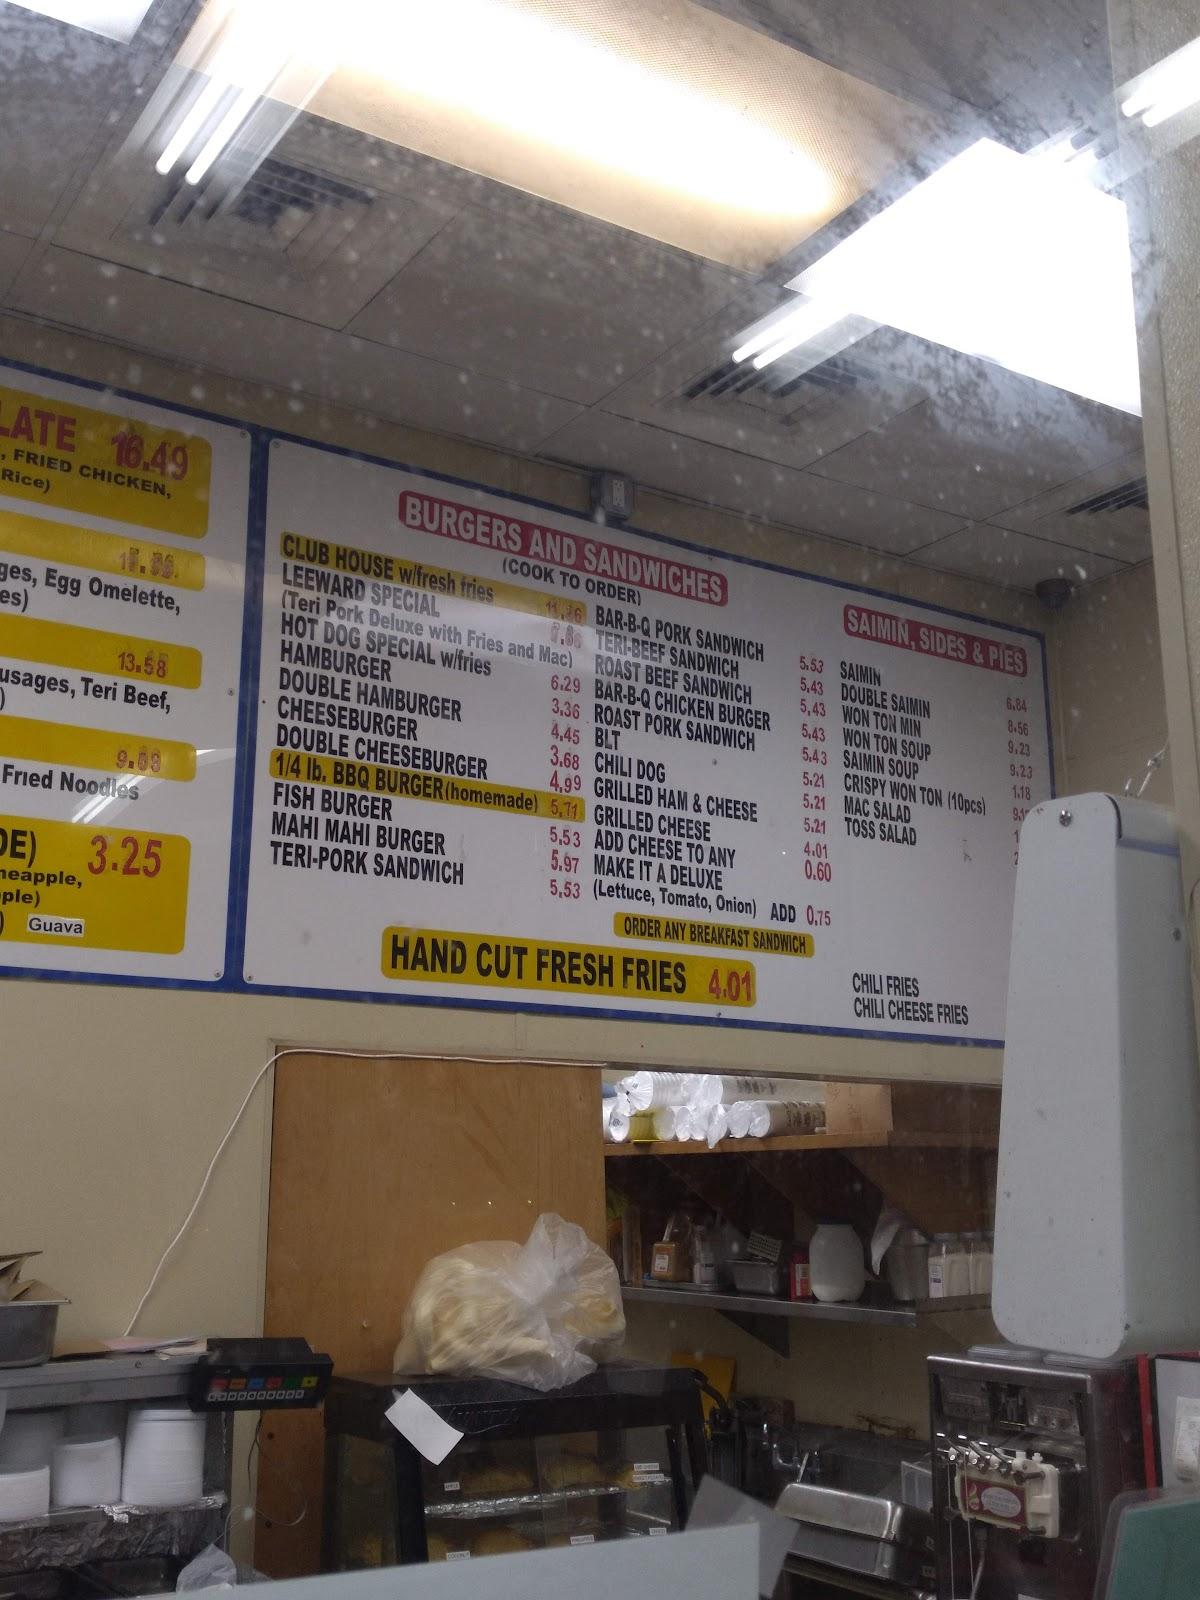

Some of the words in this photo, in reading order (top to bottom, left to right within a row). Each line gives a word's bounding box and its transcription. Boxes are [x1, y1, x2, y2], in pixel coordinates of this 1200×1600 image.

[1, 468, 51, 494] Rice)
[14, 449, 72, 473] FRIED
[79, 458, 172, 499] CHICKEN,
[283, 534, 330, 565] CLUB
[335, 547, 394, 580] HOUSE
[399, 564, 456, 595] w/fresh
[461, 579, 494, 603] fries
[405, 496, 521, 552] BURGERS
[529, 529, 577, 566] AND
[584, 543, 722, 603] SANDWICHES
[45, 567, 81, 597] Egg
[89, 577, 180, 615] Omelette,
[283, 562, 365, 601] LEEWARD
[371, 582, 440, 618] SPECIAL
[503, 557, 555, 584] (COOK
[560, 571, 579, 590] TO
[585, 579, 642, 606] ORDER)
[282, 590, 320, 614] (Teri
[327, 600, 363, 624] Pork
[370, 609, 423, 636] Deluxe
[429, 623, 461, 645] with
[468, 629, 503, 653] Fries
[508, 643, 534, 659] and
[539, 645, 572, 668] Mac)
[282, 613, 317, 640] HOT
[324, 621, 360, 649] DOG
[367, 630, 435, 665] SPECIAL
[441, 649, 491, 676] w/fries
[551, 675, 580, 693] 6.29
[596, 605, 650, 637] BAR-B-Q
[656, 620, 691, 644] PORK
[696, 629, 763, 661] SANDWICH
[800, 656, 824, 674] 5.53
[596, 630, 665, 663] TERI-BEEF
[670, 647, 738, 679] SANDWICH
[847, 609, 916, 650] SAIMIN,
[919, 628, 967, 661] SIDES
[973, 642, 984, 666] &
[989, 646, 1024, 674] PIES
[81, 677, 117, 700] Teri
[124, 688, 171, 713] Beef,
[281, 640, 391, 682] HAMBURGER
[552, 698, 580, 719] 3.36
[595, 654, 641, 682] ROAST
[645, 665, 678, 689] BEEF
[683, 673, 752, 704] SANDWICH
[840, 660, 881, 687] SAIMIN
[1007, 697, 1028, 714] 6.84
[280, 667, 350, 701] DOUBLE
[357, 681, 462, 722] HAMBURGER
[551, 723, 580, 745] 4.45
[595, 679, 650, 708] BAR-B-Q
[655, 691, 714, 720] CHICKEN
[719, 703, 771, 731] BURGER
[802, 724, 826, 742] 5.43
[841, 683, 888, 711] DOUBLE
[891, 694, 930, 719] SAIMIN
[1008, 720, 1029, 736] 8.56
[842, 705, 870, 728] WON
[873, 711, 897, 733] TON
[900, 717, 921, 738] MIN
[1008, 741, 1030, 757] 9.23
[277, 724, 349, 757] DOUBLE
[355, 737, 487, 780] CHEESEBURGER
[278, 696, 417, 741] CHEESEBURGER
[550, 745, 580, 770] 3.68
[595, 704, 640, 731] ROAST
[645, 713, 682, 738] PORK
[686, 721, 755, 751] SANDWICH
[802, 747, 827, 765] 5.43
[595, 727, 620, 750] BLT
[803, 772, 825, 788] 5.21
[843, 728, 870, 751] WON
[874, 734, 898, 756] TON
[901, 739, 931, 762] SOUP
[1010, 763, 1033, 780] 9.23
[3, 764, 53, 789] Fried
[61, 772, 139, 801] Noodles
[276, 753, 300, 777] 1/4
[307, 758, 326, 782] lb.
[334, 762, 369, 790] BBQ
[595, 752, 631, 777] CHILI
[637, 760, 666, 783] DOG
[803, 794, 826, 811] 5.21
[844, 749, 885, 774] SAIMIN
[888, 757, 919, 780] SOUP
[1012, 785, 1031, 801] 1.18
[844, 773, 886, 797] CRISPY
[890, 780, 916, 803] WON
[919, 786, 943, 808] TON
[948, 791, 986, 816] (10pcs)
[273, 782, 315, 810] FISH
[321, 790, 392, 821] BURGER
[550, 827, 581, 848] 5.53
[594, 777, 652, 805] GRILLED
[658, 788, 687, 811] HAM
[693, 793, 702, 813] &
[707, 796, 758, 822] CHEESE
[804, 818, 826, 834] 5.21
[594, 805, 653, 832] GRILLED
[658, 815, 710, 842] CHEESE
[804, 842, 828, 858] 4.01
[844, 796, 870, 817] MAC
[874, 801, 911, 824] SALAD
[845, 817, 875, 839] TOSS
[879, 823, 917, 846] SALAD
[88, 835, 163, 878] 3.25
[270, 841, 368, 875] TERI-PORK
[374, 853, 464, 885] SANDWICH
[272, 812, 318, 840] MAHI
[325, 819, 370, 846] MAHI
[376, 826, 446, 855] BURGER
[551, 849, 580, 874] 5.97
[594, 829, 623, 852] ADD
[628, 834, 683, 862] CHEESE
[687, 843, 704, 864] TO
[709, 849, 736, 869] ANY
[805, 860, 832, 882] 0.60
[594, 854, 634, 880] MAKE
[640, 861, 652, 881] IT
[656, 863, 666, 884] A
[671, 866, 722, 891] DELUXE
[28, 918, 83, 935] Guava
[593, 879, 655, 906] (Lettuce,
[659, 887, 711, 913] Tomato,
[716, 895, 757, 919] Onion)
[770, 903, 796, 923] ADD
[806, 905, 831, 927] 0.75
[624, 916, 661, 938] ORDER
[664, 921, 686, 940] ANY
[690, 923, 750, 948] BREAKFAST
[753, 933, 806, 954] SANDWICH
[391, 934, 467, 975] HAND
[476, 942, 528, 981] CUT
[536, 949, 614, 988] FRESH
[622, 957, 687, 994] FRIES
[709, 969, 752, 1002] 4.01
[853, 973, 883, 995] CHILI
[887, 976, 919, 997] FRIES
[854, 997, 884, 1019] CHILI
[889, 1000, 934, 1022] CHEESE
[937, 1004, 968, 1025] FRIES
